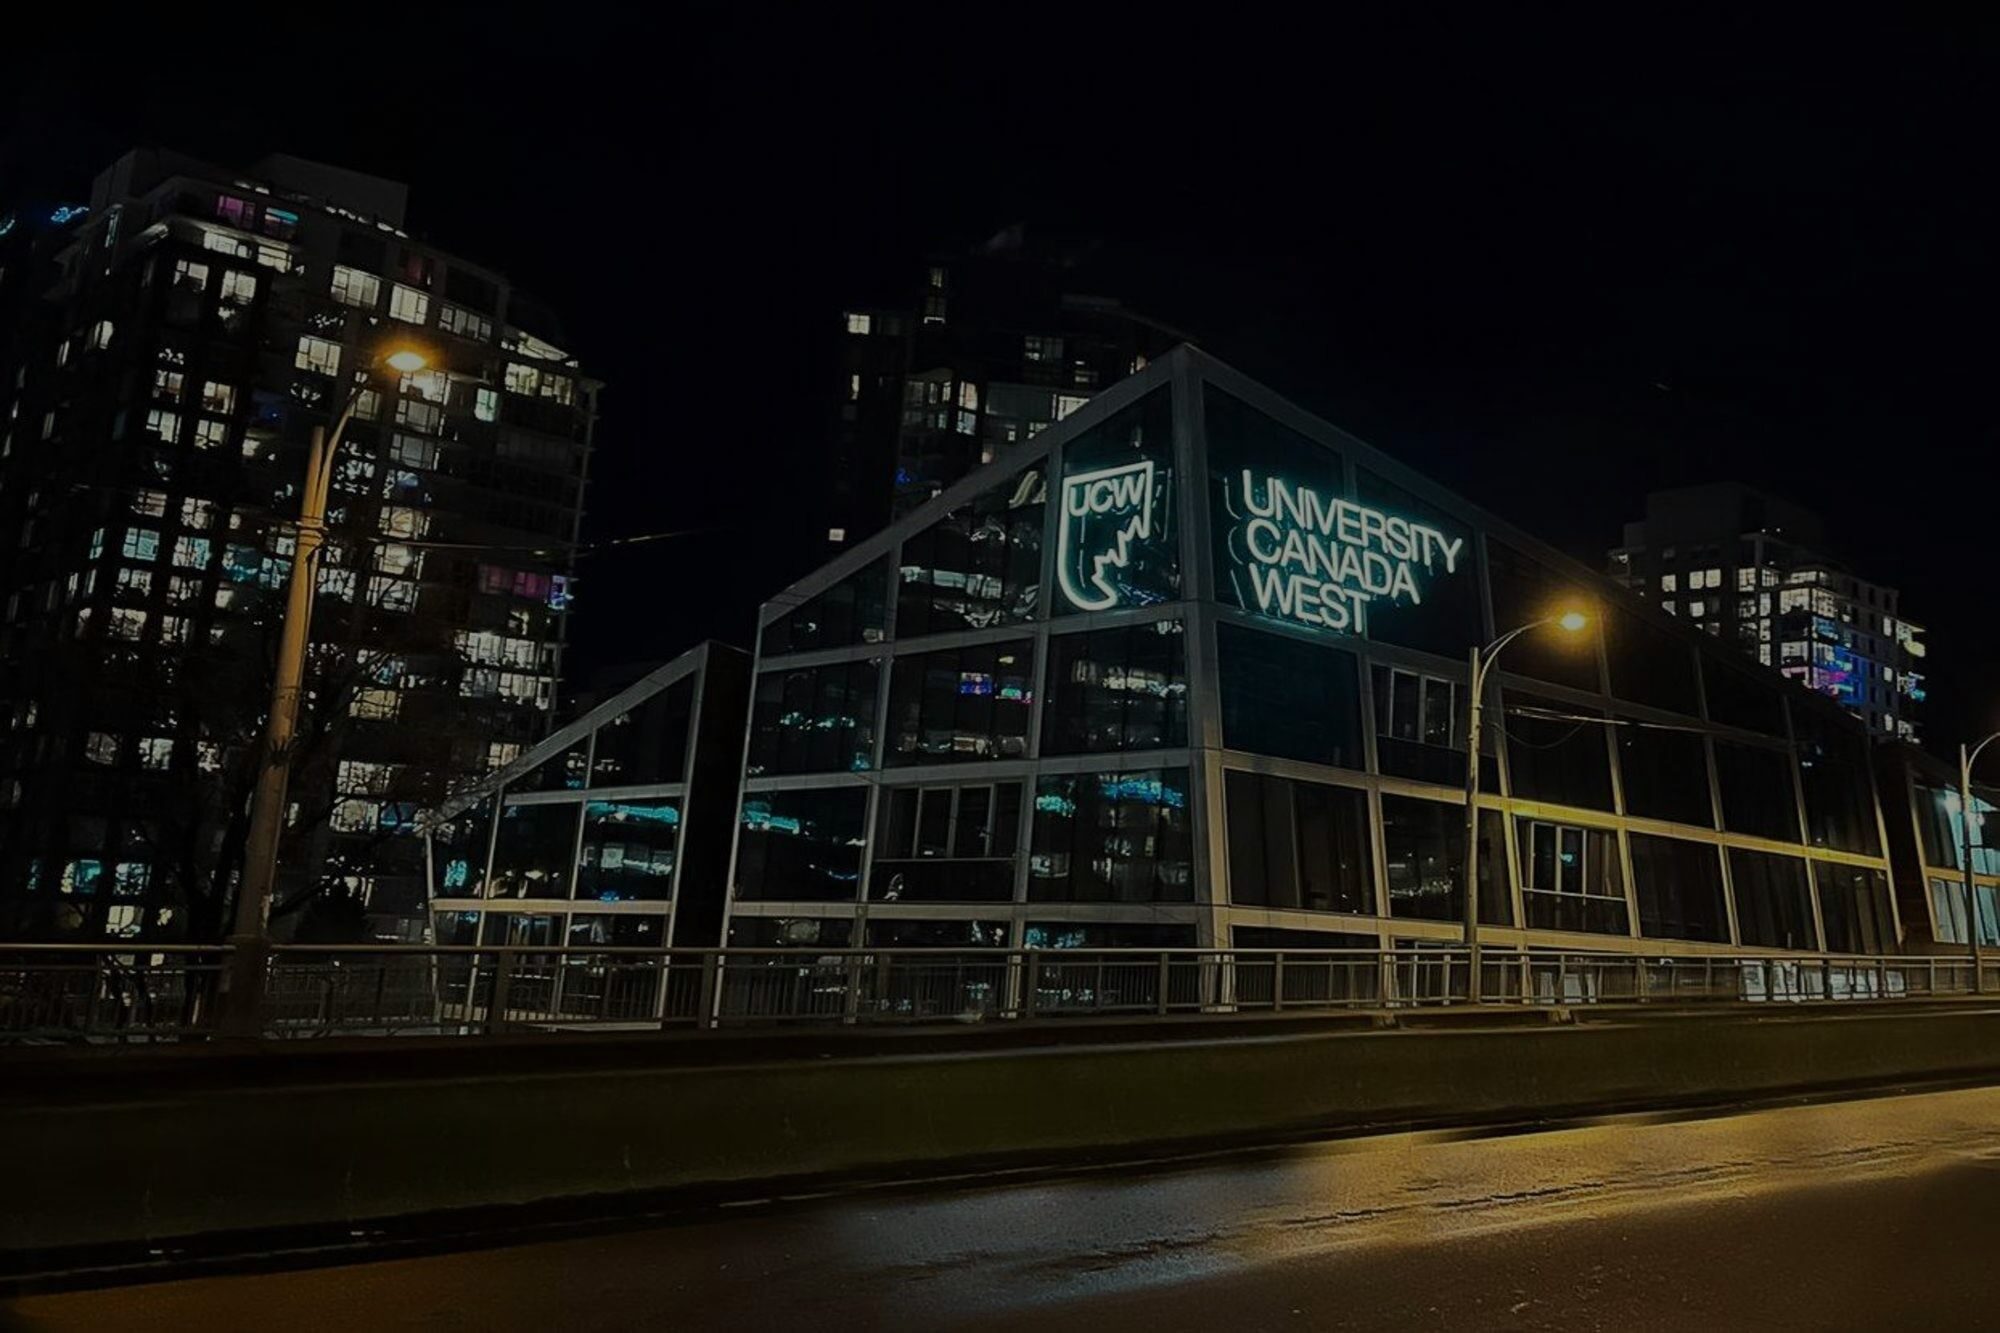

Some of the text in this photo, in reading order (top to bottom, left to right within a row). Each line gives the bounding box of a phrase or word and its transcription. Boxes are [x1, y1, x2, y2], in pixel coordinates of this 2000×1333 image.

[1069, 472, 1146, 517] UCW
[1242, 469, 1463, 574] UNIVERSITY
[1247, 518, 1421, 605] CANADA
[1249, 562, 1371, 633] WEST
